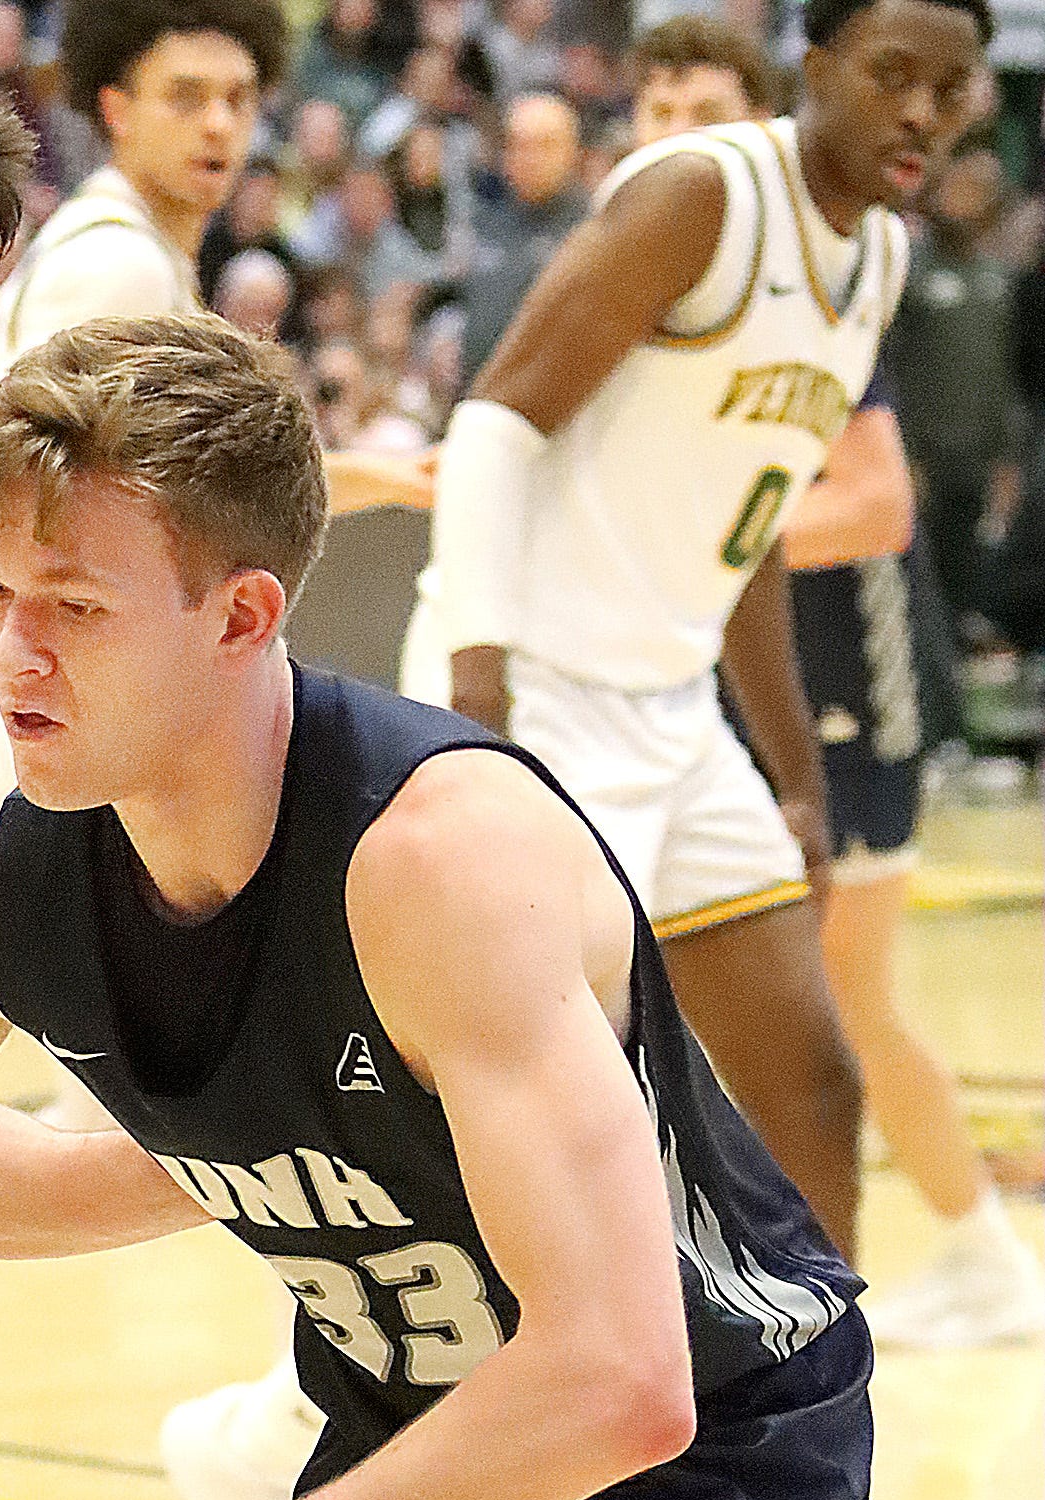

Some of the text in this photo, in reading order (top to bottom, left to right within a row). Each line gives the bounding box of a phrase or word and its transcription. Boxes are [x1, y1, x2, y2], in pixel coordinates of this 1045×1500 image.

[717, 464, 792, 571] 0
[147, 1146, 415, 1229] UNH
[260, 1240, 504, 1387] 33
